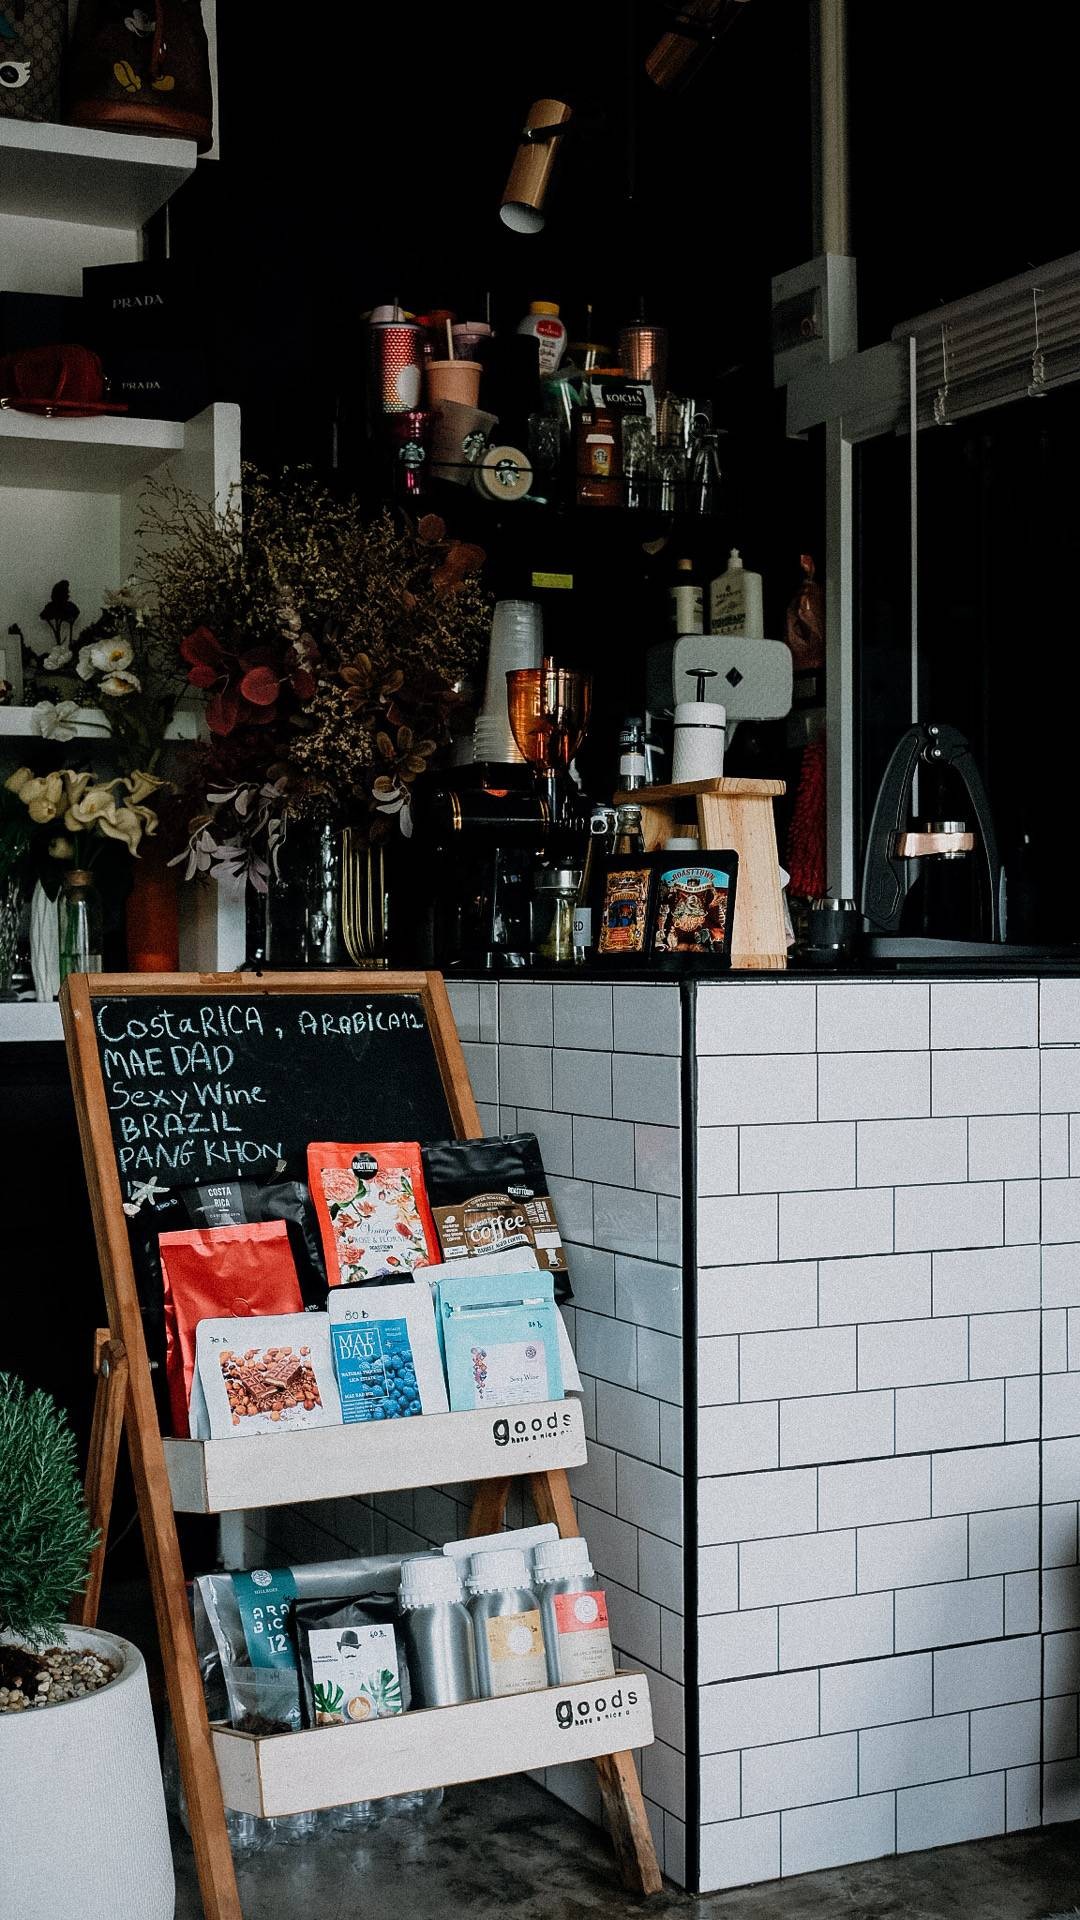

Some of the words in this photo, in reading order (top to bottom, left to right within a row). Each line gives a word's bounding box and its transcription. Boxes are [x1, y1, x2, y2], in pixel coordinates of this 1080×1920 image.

[112, 294, 164, 309] PRADA
[121, 381, 161, 390] PRADA
[104, 1048, 165, 1079] MAE
[170, 1041, 235, 1075] DAD
[110, 1081, 188, 1114] Sexy
[193, 1081, 266, 1106] Wine
[120, 1110, 242, 1143] BRAZIL
[119, 1139, 196, 1173] PANG
[203, 1139, 282, 1166] KHON
[207, 1186, 232, 1197] COSTA
[213, 1198, 230, 1207] RICA
[338, 1332, 375, 1347] MAE
[340, 1343, 374, 1359] DAD
[493, 1412, 571, 1446] goods
[556, 1689, 638, 1730] goods
